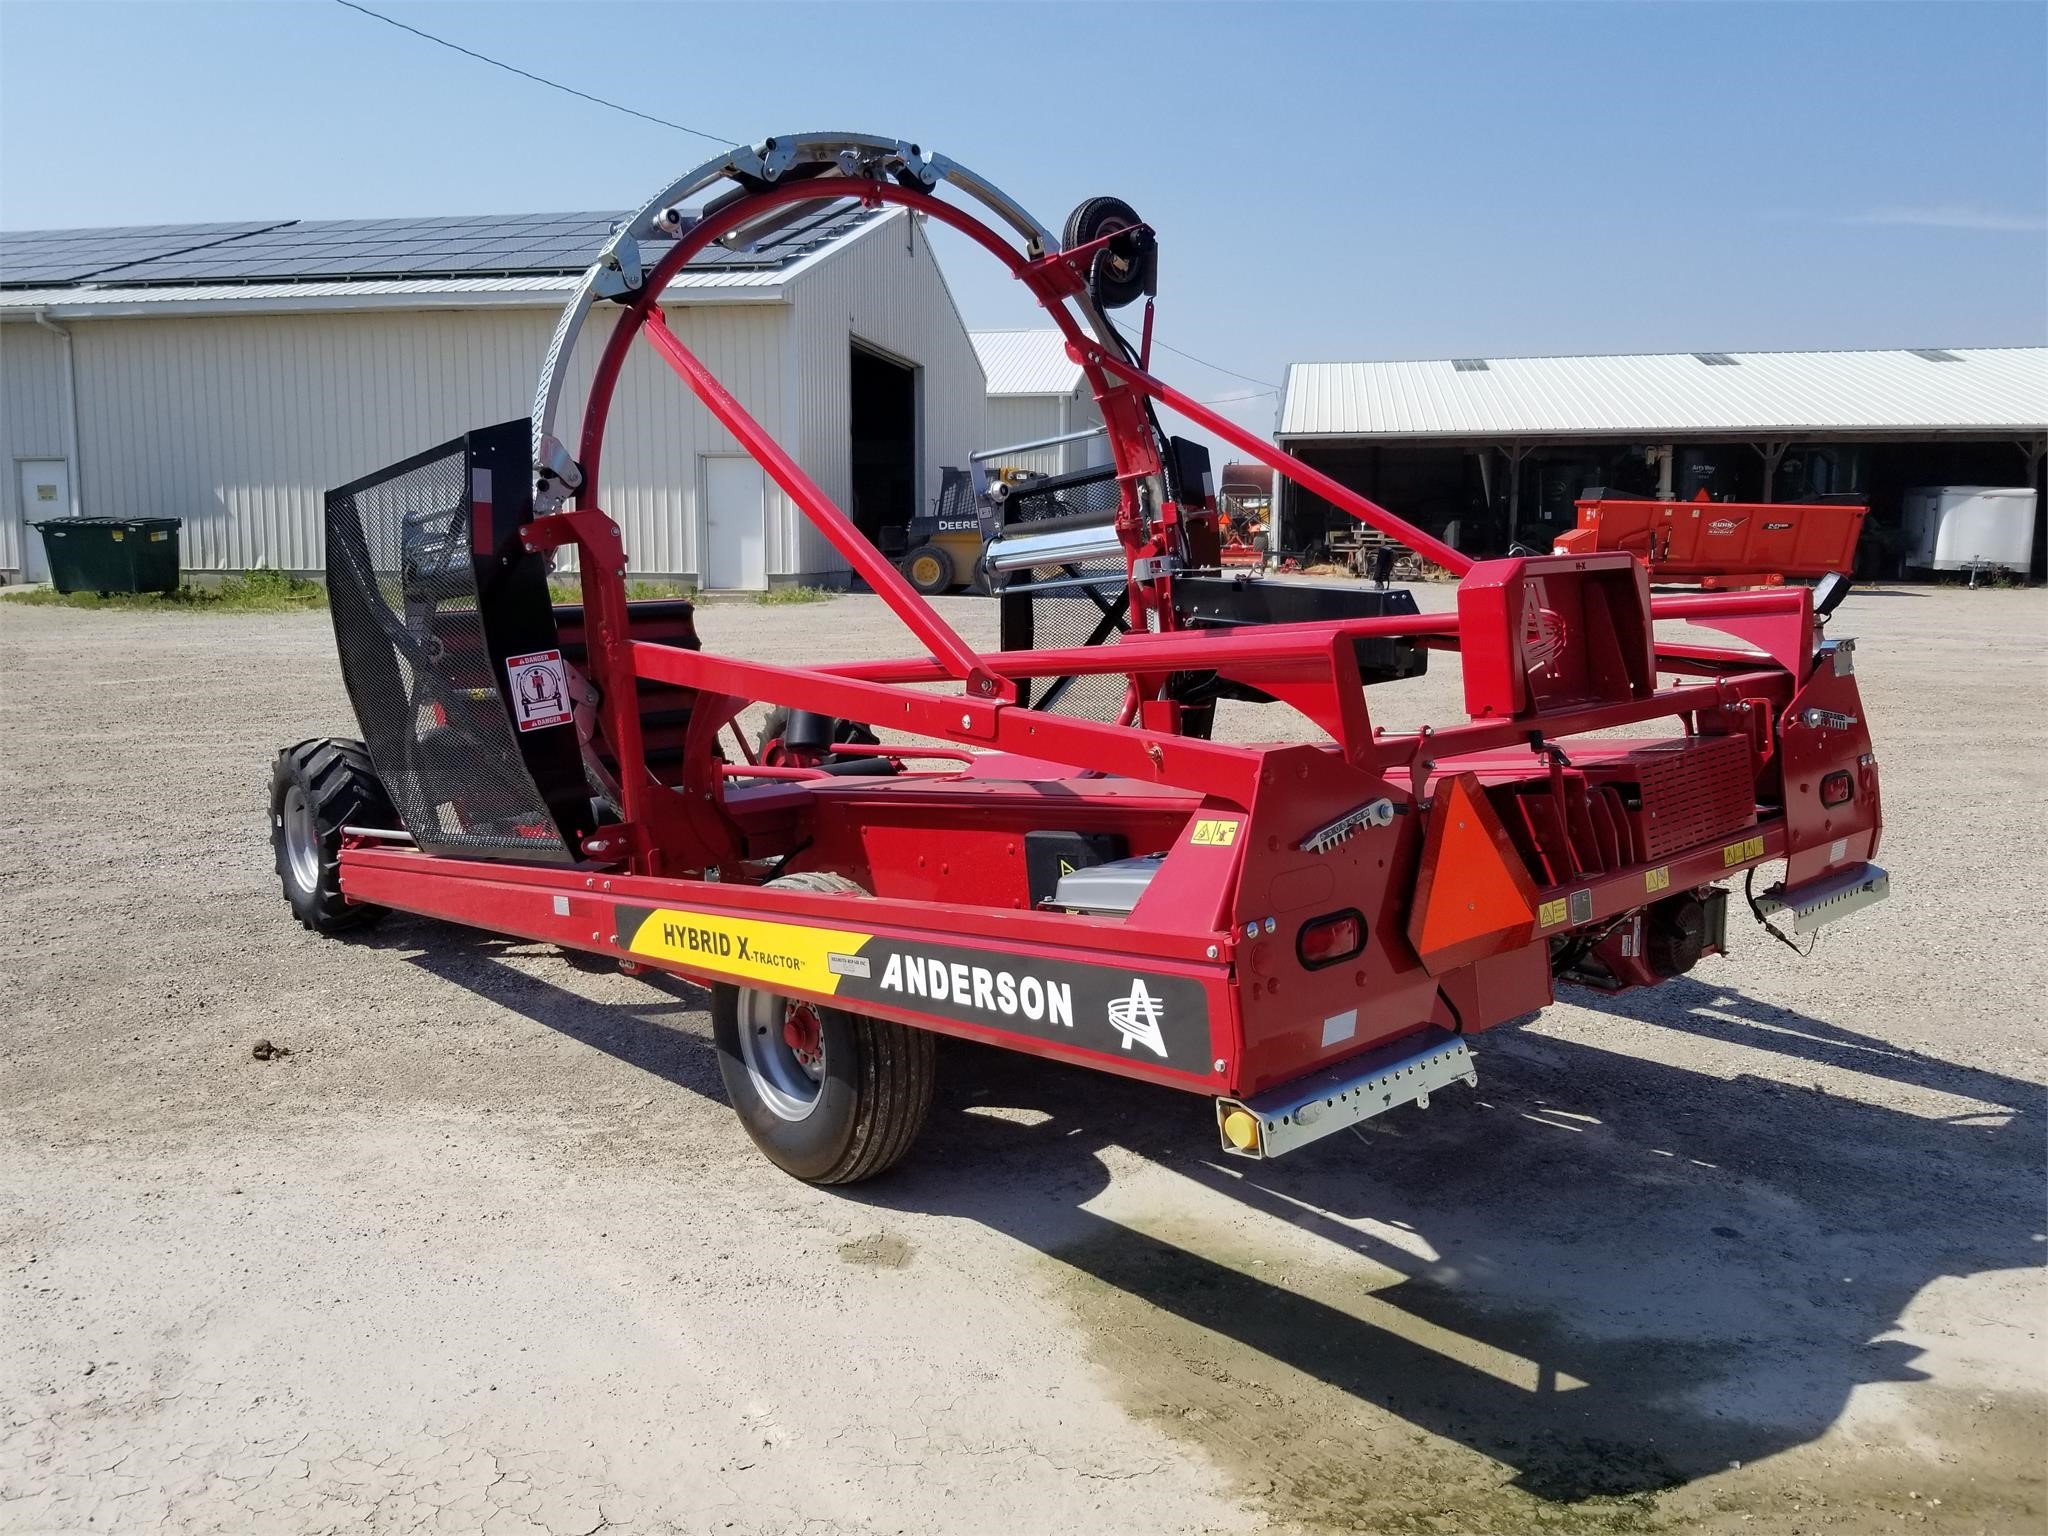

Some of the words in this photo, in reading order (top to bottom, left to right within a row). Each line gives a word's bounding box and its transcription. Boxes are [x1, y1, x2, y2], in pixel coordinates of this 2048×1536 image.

[938, 520, 978, 531] DEERE
[525, 654, 549, 664] DANGER
[537, 715, 562, 726] DANGER
[663, 922, 731, 957] HYBRID
[879, 953, 1074, 1028] ANDERSON
